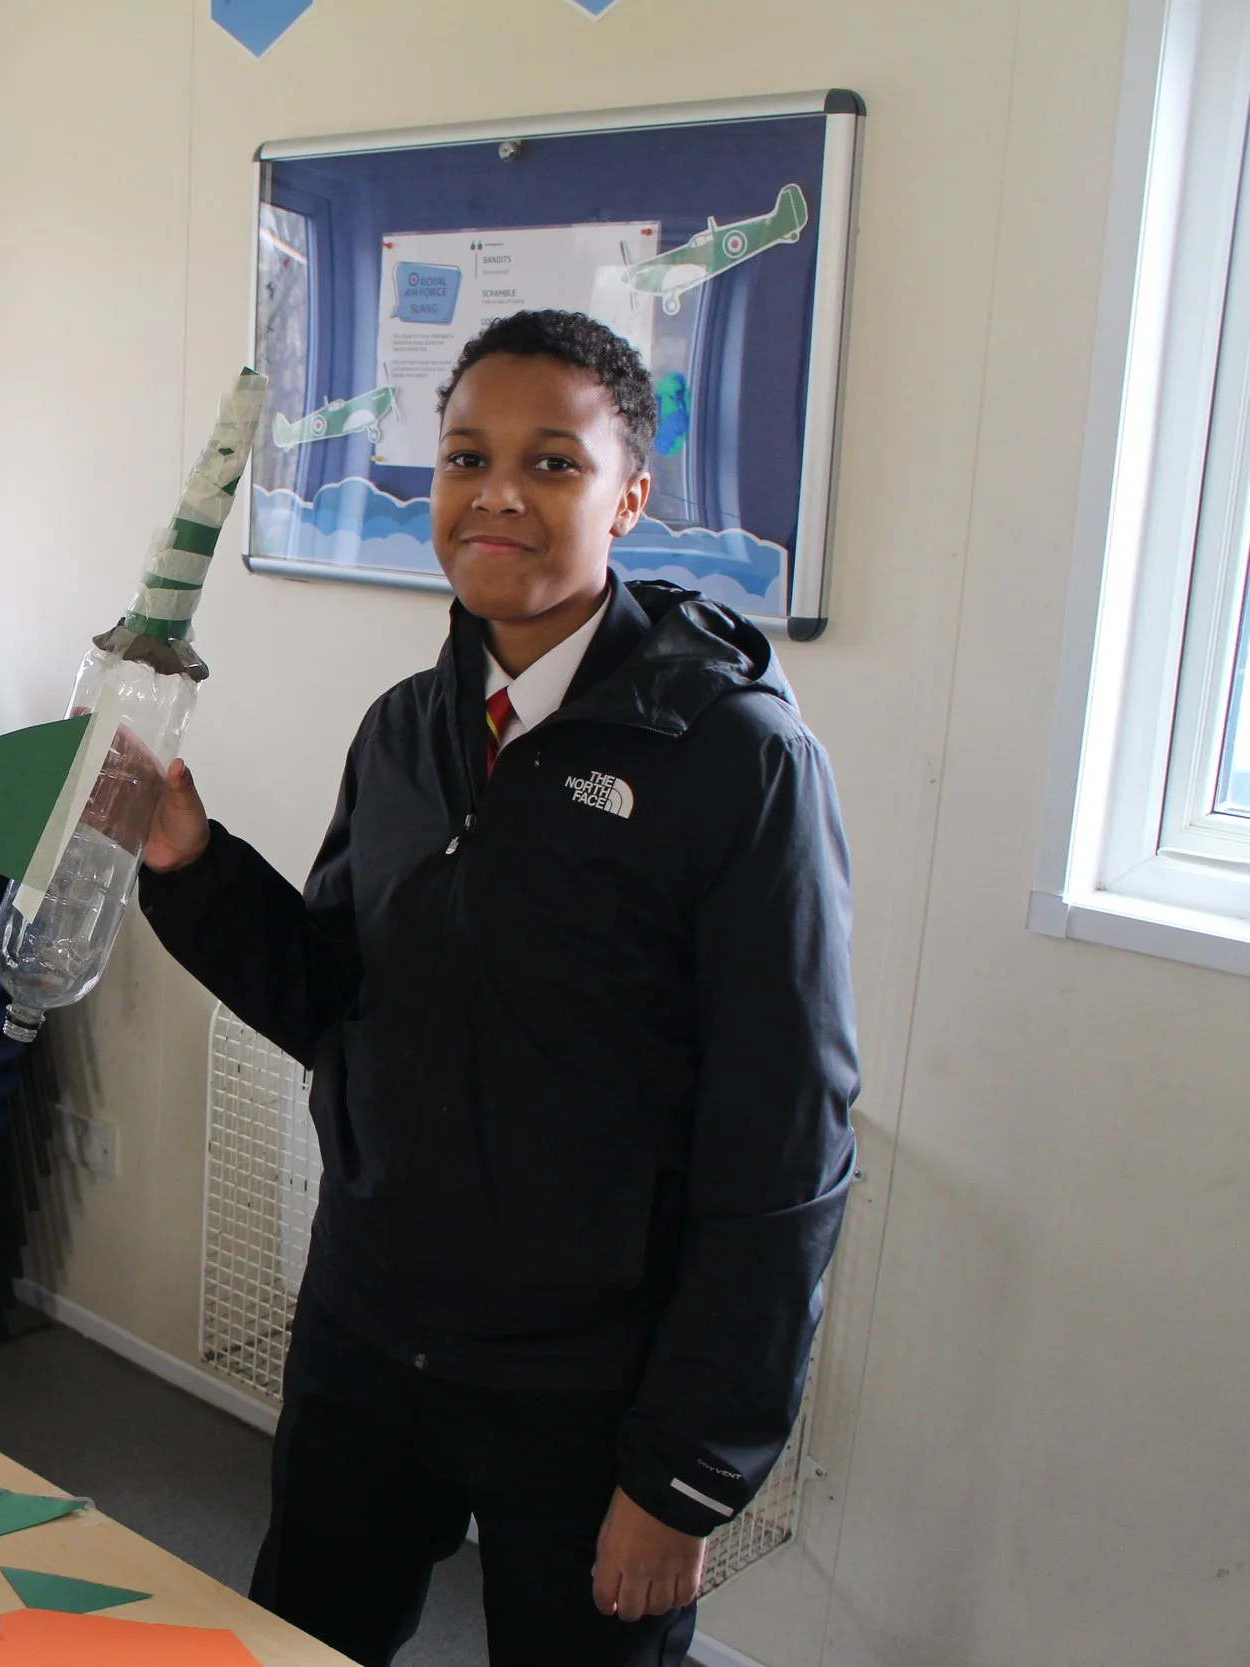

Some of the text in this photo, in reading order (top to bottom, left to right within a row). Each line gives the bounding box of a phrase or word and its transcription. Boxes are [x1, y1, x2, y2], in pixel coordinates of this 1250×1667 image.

[483, 255, 512, 264] BANDITS
[420, 276, 447, 286] ROYAL
[403, 287, 447, 297] AIR FORCE
[482, 289, 516, 298] SCRAMBLE
[410, 303, 438, 313] SLANG
[590, 770, 615, 788] THE
[564, 776, 611, 799] NORTH
[572, 790, 607, 809] FACE
